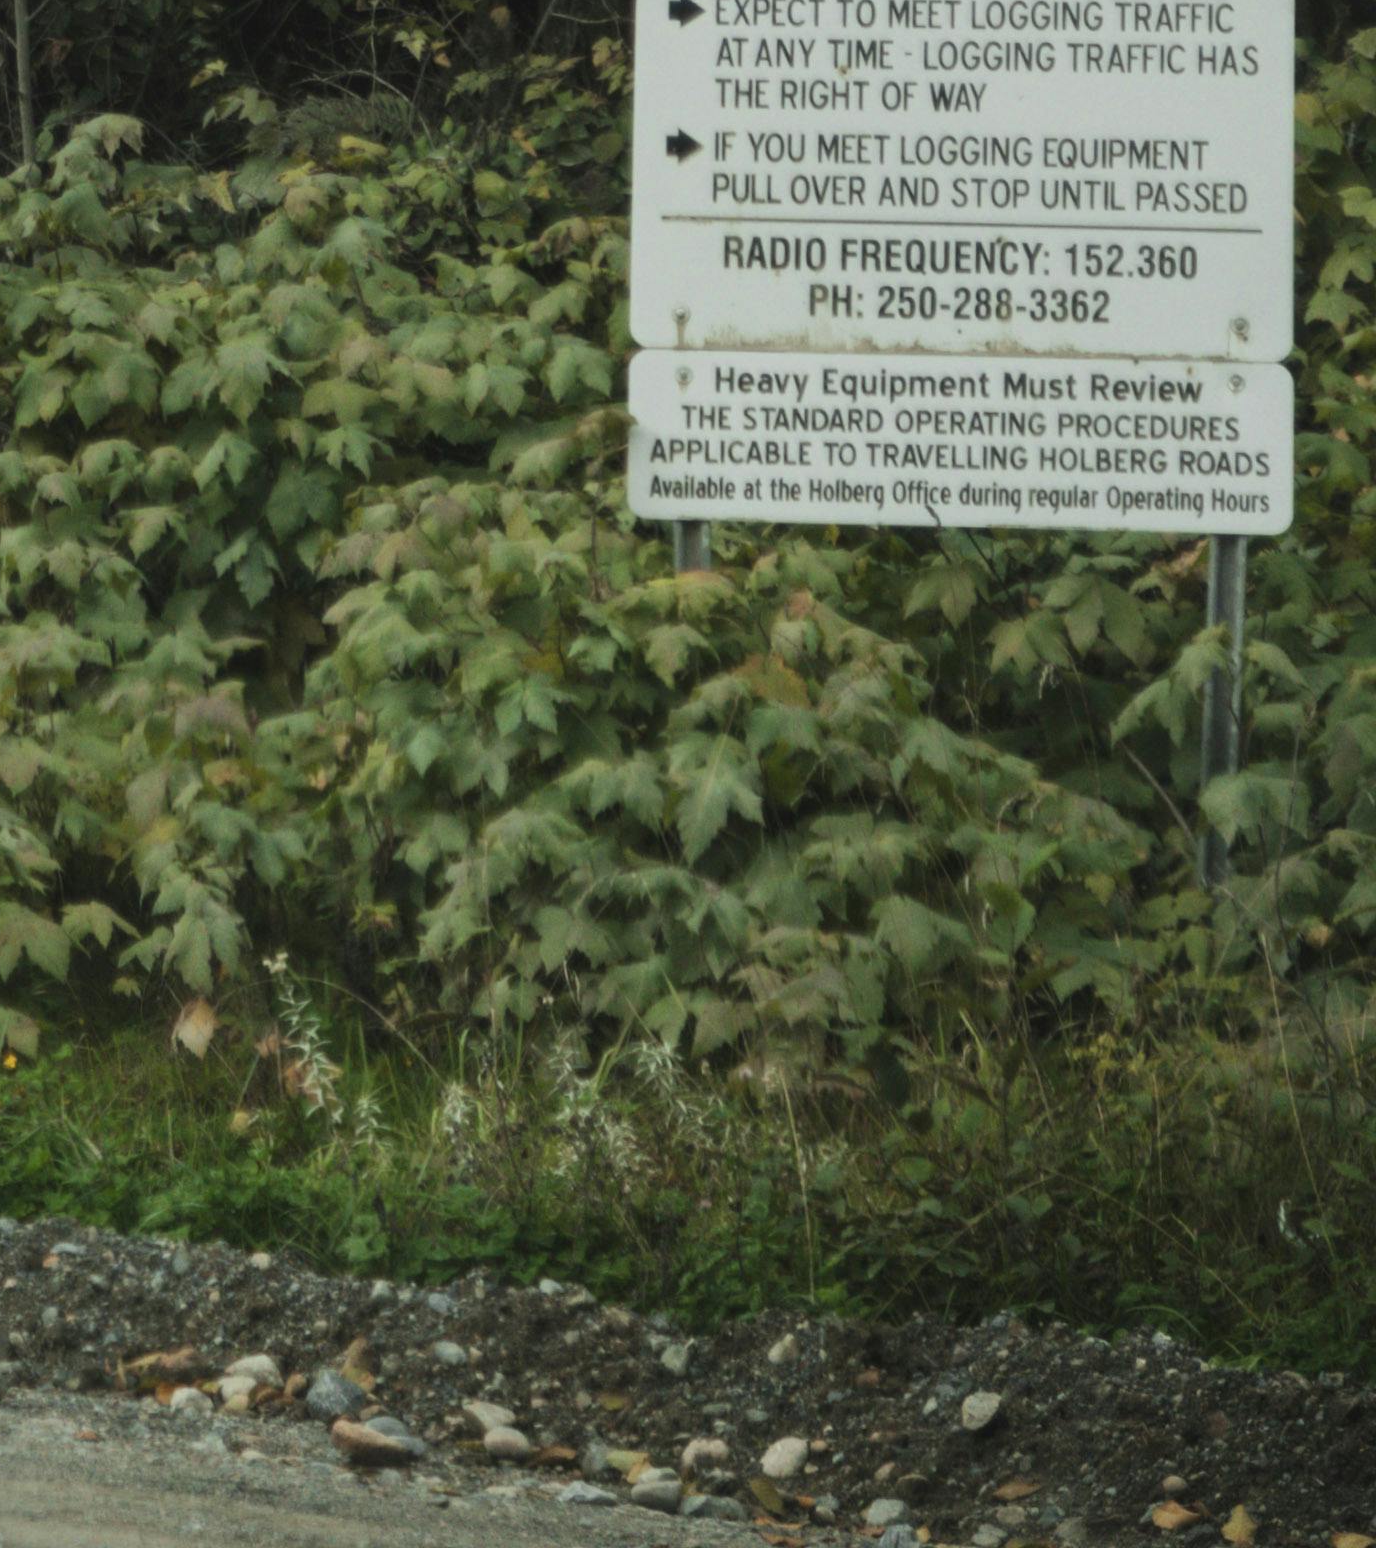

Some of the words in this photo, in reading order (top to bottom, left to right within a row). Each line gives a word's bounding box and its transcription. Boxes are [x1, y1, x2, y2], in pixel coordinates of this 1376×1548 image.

[970, 0, 1106, 33] LOGGING
[1115, 0, 1236, 36] TRAFFIC
[715, 38, 753, 71] AT
[754, 38, 817, 71] ANY
[827, 39, 894, 72] TIME
[923, 40, 1057, 74] LOGGING
[1067, 41, 1188, 77] TRAFFIC
[1196, 43, 1260, 79] HAS
[715, 77, 771, 110] THE
[779, 79, 871, 111] RIGHT
[881, 80, 922, 113] OF
[929, 81, 988, 115] WAY
[714, 131, 738, 164] IF
[747, 132, 807, 165] YOU
[816, 133, 891, 166] MEET
[899, 134, 1034, 169] LOGGING
[1044, 136, 1211, 174] EQUIPMENT
[711, 173, 784, 207] PULL
[789, 174, 865, 208] OVER
[877, 175, 940, 210] AND
[950, 176, 1030, 211] STOP
[1040, 178, 1126, 214] UNTIL
[1137, 179, 1249, 216] PASSED
[722, 235, 827, 273] RADIO
[841, 238, 1051, 279] FREQUENCY:
[1065, 243, 1199, 281] 152.360
[807, 286, 865, 319] PH:
[876, 286, 1111, 326] 250-288-3362
[714, 367, 808, 404] Heavy
[821, 369, 992, 405] Equipment
[1003, 372, 1077, 404] Must
[1089, 373, 1205, 405] Review
[681, 404, 733, 433] THE
[742, 405, 886, 437] STANDARD
[894, 409, 1047, 440] OPERATING
[1057, 412, 1241, 442] PROCEDURES
[649, 438, 812, 468] APPLICABLE
[823, 442, 856, 470] TO
[865, 442, 1028, 473] TRAVELLING
[1039, 445, 1168, 476] HOLBERG
[1176, 448, 1271, 478] ROADS
[648, 477, 736, 503] Available
[743, 478, 763, 503] at
[768, 477, 802, 504] the
[807, 478, 886, 510] Holberg
[891, 481, 951, 507] Office
[958, 481, 1022, 514] during
[1027, 483, 1100, 514] regular
[1105, 485, 1204, 519] Operating
[1210, 487, 1270, 514] Hours
